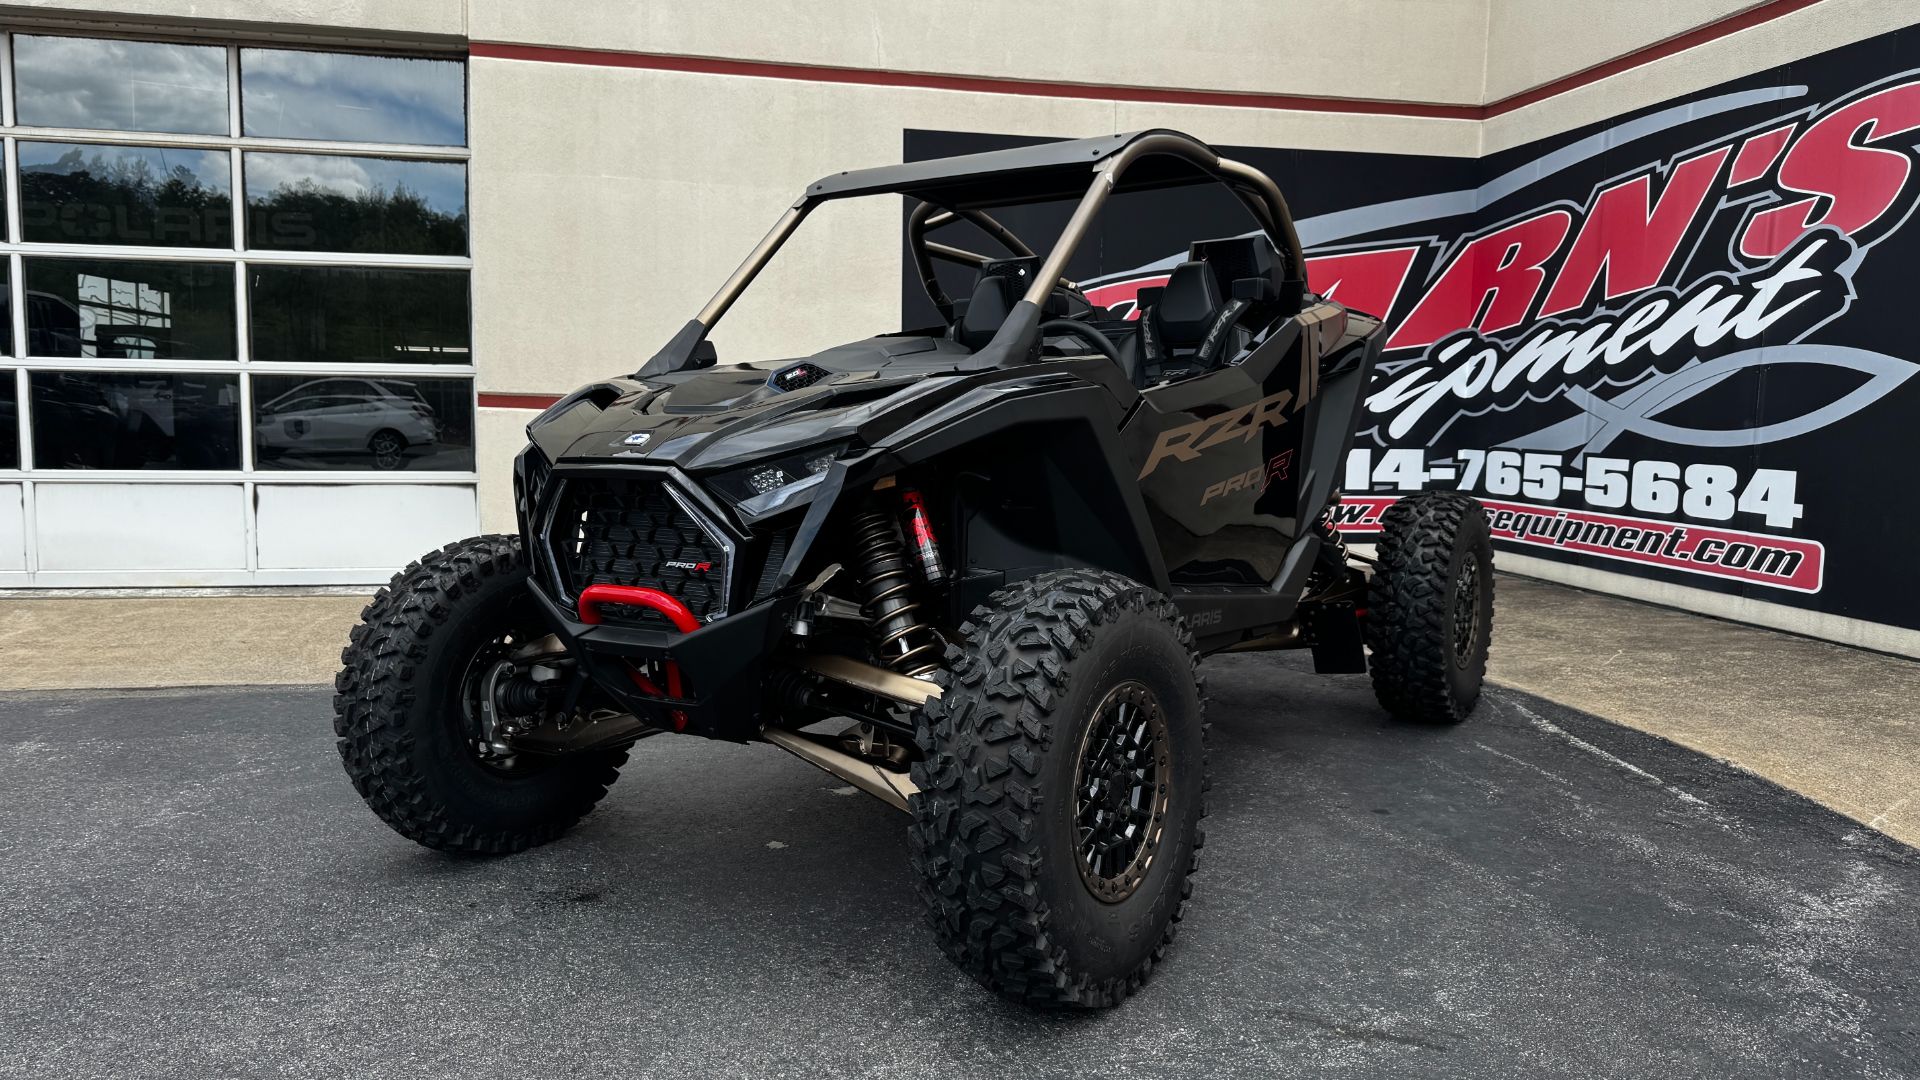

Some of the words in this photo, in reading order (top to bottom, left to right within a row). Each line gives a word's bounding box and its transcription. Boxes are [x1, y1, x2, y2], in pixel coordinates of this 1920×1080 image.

[1137, 389, 1294, 481] RZR
[1345, 448, 1803, 528] 14-765-5684
[1184, 609, 1222, 629] LARIS
